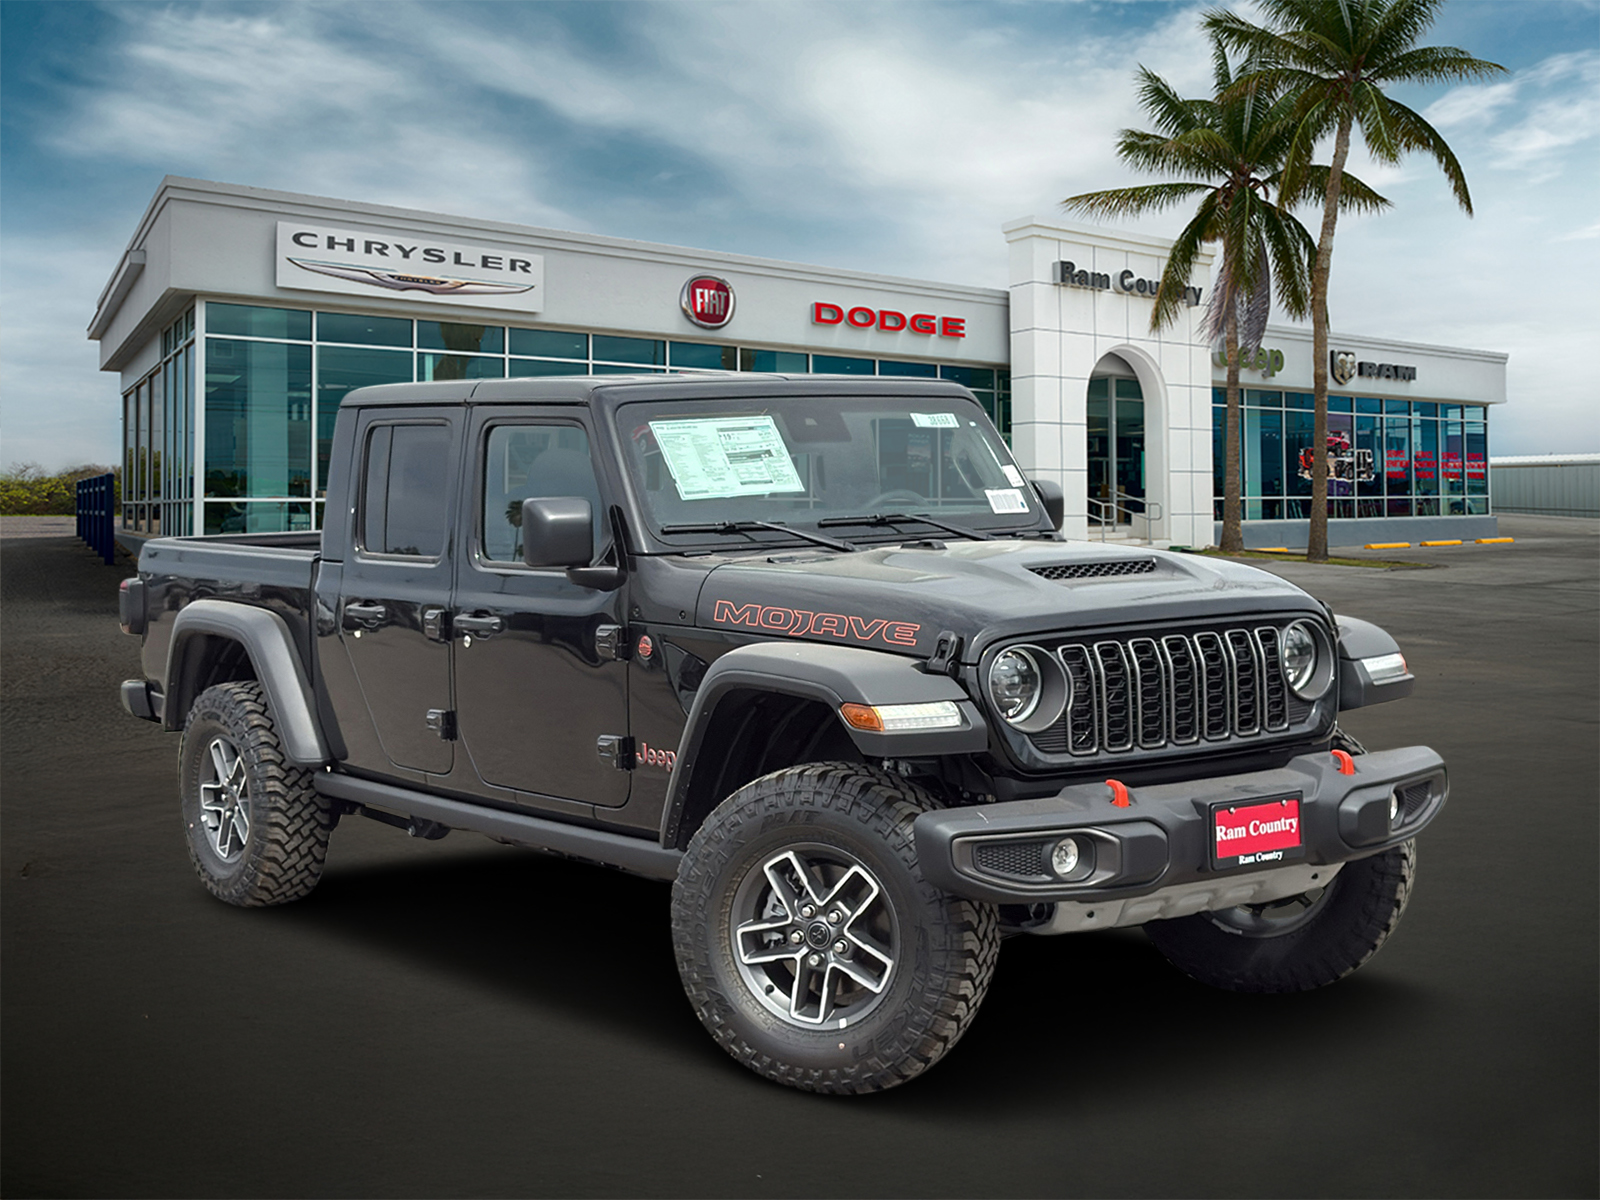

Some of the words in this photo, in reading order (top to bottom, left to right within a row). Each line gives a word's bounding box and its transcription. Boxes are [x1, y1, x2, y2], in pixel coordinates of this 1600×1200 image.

[292, 232, 532, 274] CHRYSLER
[1053, 260, 1110, 290] Ram
[1113, 269, 1203, 307] Coury
[695, 287, 728, 316] FIAT
[812, 301, 966, 338] DODGE
[1358, 361, 1417, 380] RAM
[713, 599, 921, 647] MOJAVE
[635, 742, 678, 772] Jeep
[1215, 825, 1247, 841] Ram
[1249, 817, 1298, 836] Country
[1238, 855, 1255, 865] Ram
[1256, 851, 1283, 862] Country
